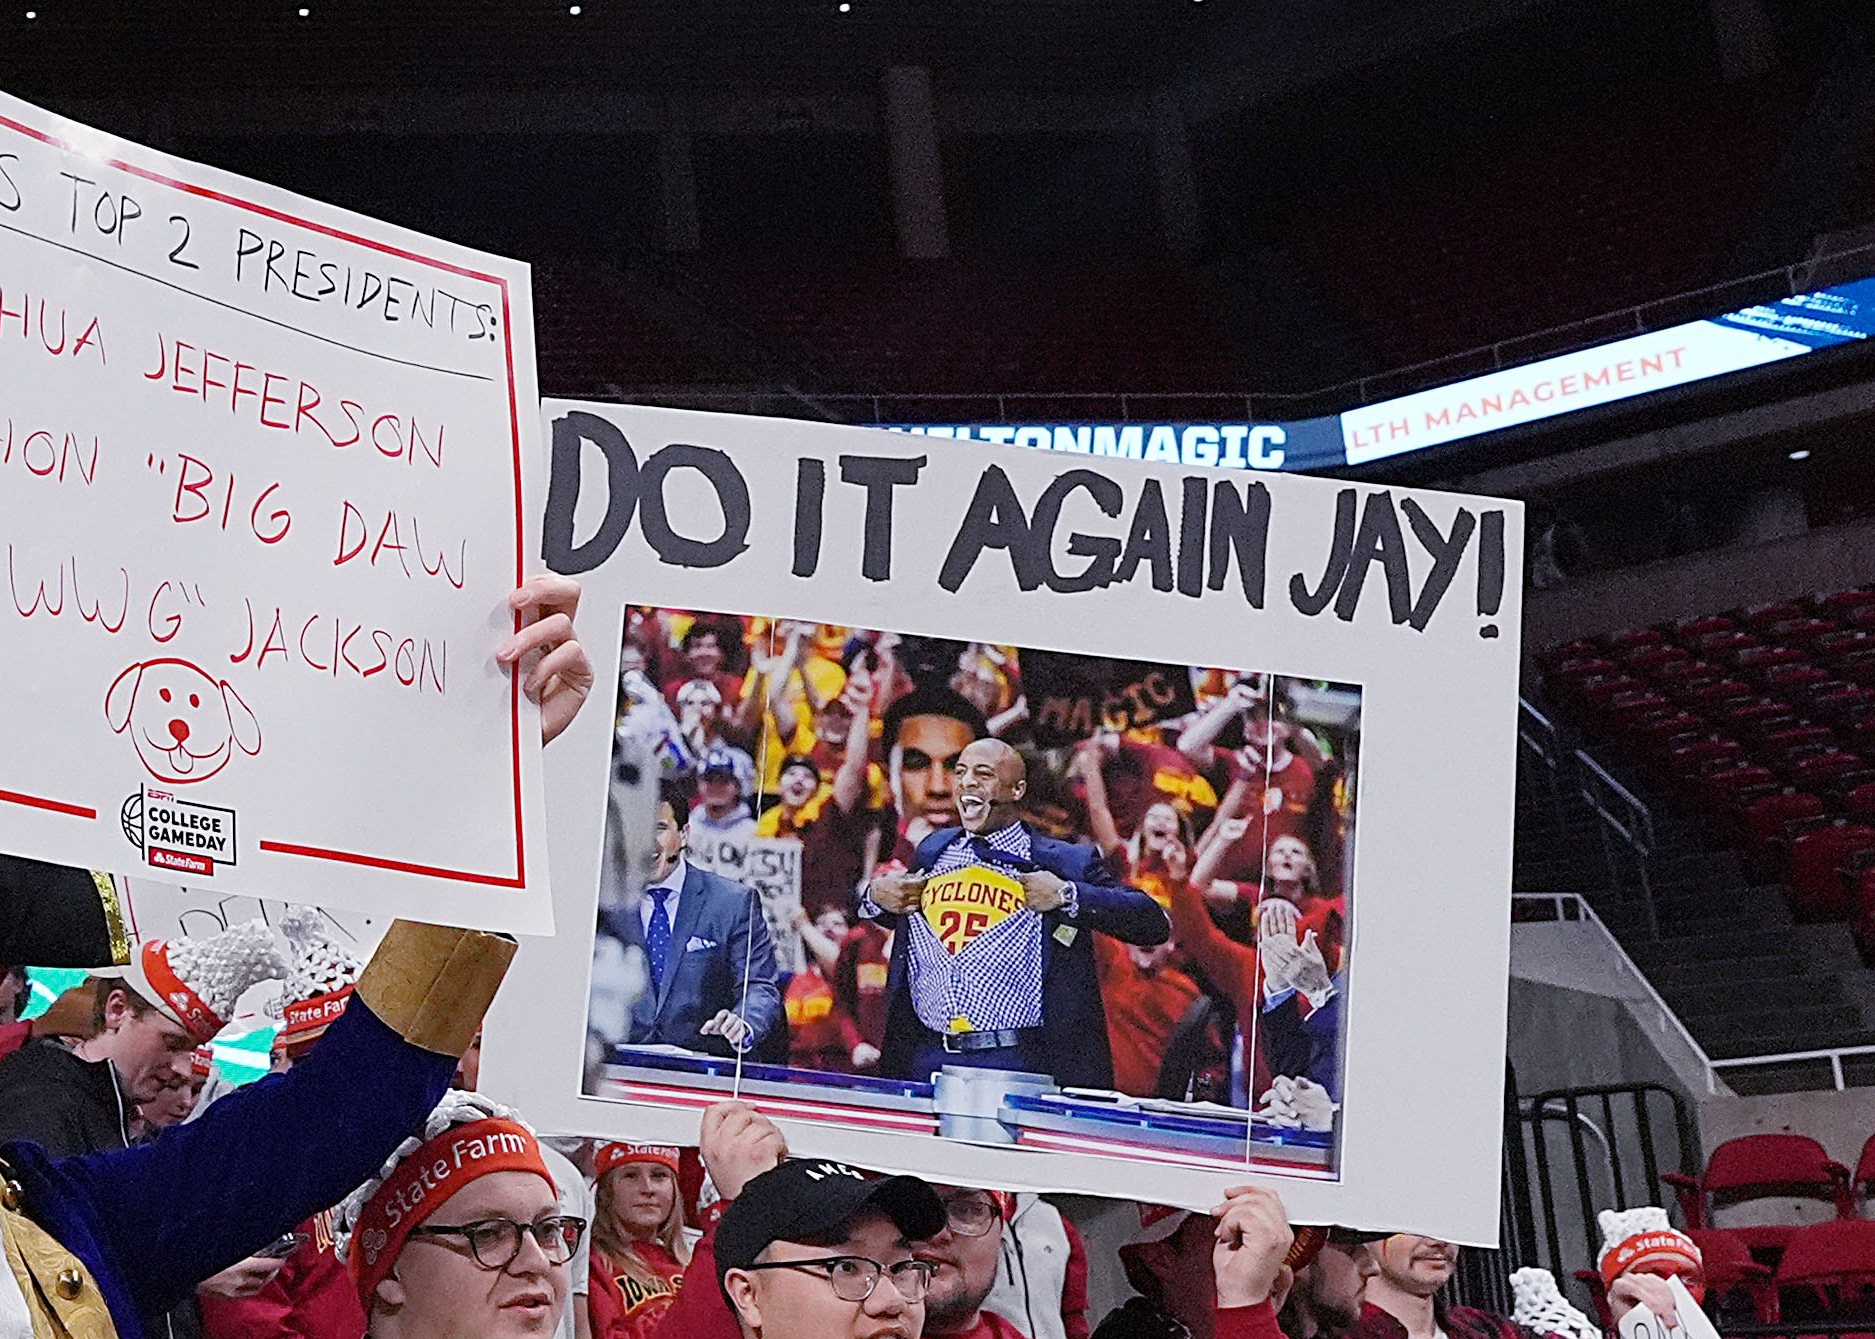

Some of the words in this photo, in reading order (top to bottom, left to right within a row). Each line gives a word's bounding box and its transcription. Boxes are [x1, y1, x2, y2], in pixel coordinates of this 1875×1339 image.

[60, 172, 141, 245] TOP
[168, 216, 200, 271] 2
[144, 331, 445, 470] JEFFERSON
[1352, 418, 1411, 449] LTH
[1424, 347, 1688, 432] MANAGEMENT
[335, 501, 468, 591] DAW
[543, 411, 752, 577] DO
[792, 453, 927, 584] IT
[938, 464, 1271, 609] AGAIN
[1290, 491, 1506, 640] JAY!
[230, 602, 449, 695] JACKSON
[148, 789, 175, 802] ESPN
[149, 807, 222, 833] COLLEGE
[149, 825, 226, 851] GAMEDAY
